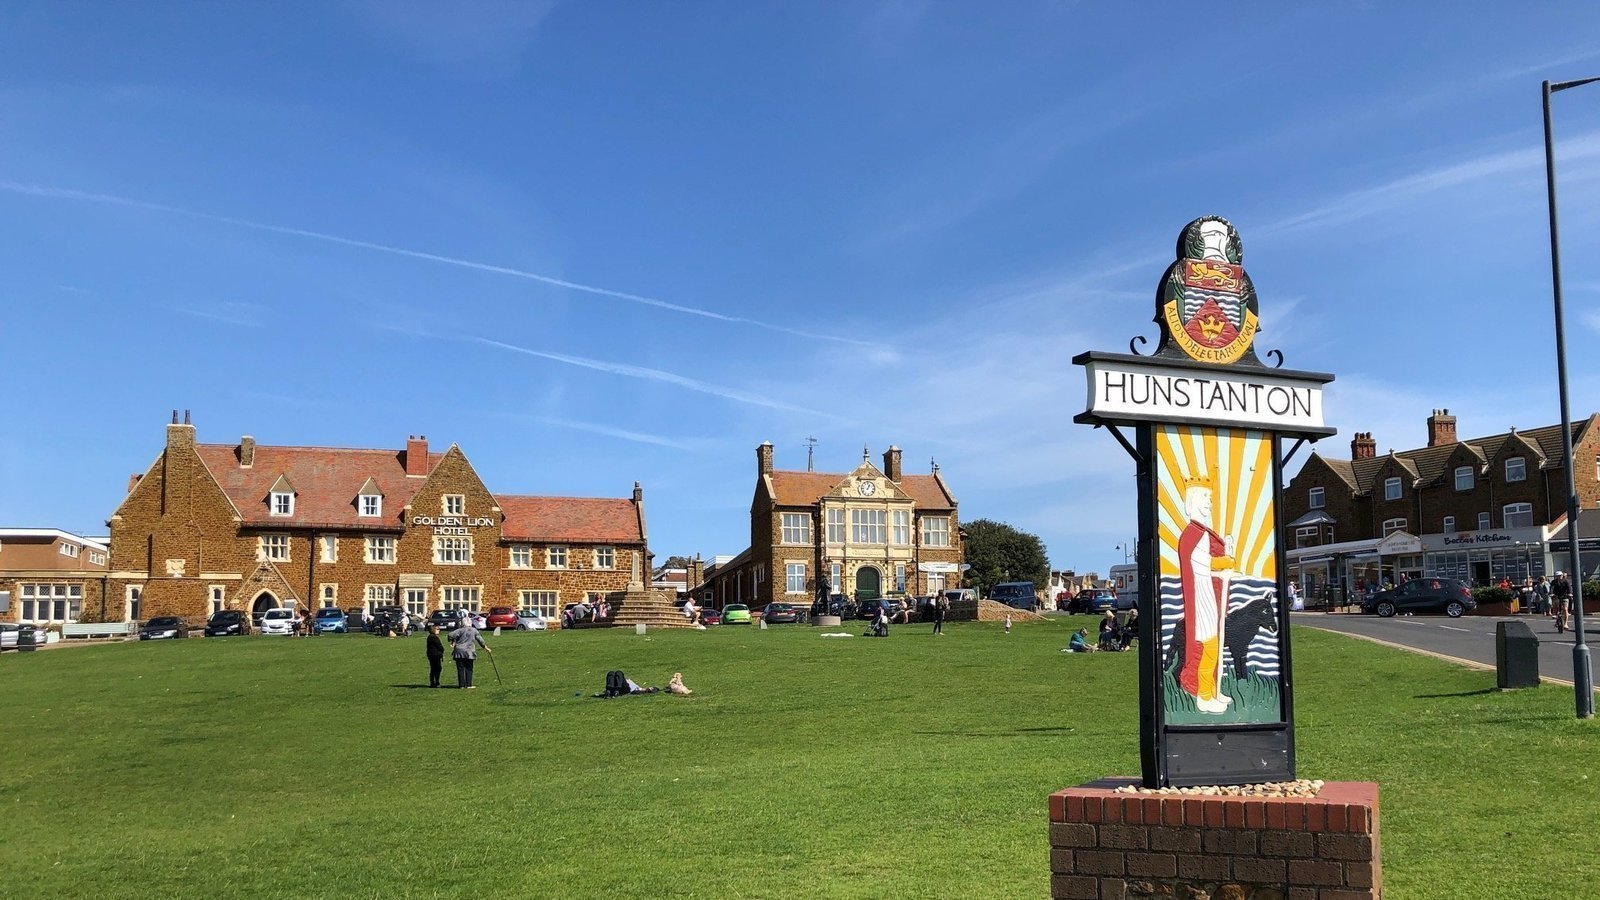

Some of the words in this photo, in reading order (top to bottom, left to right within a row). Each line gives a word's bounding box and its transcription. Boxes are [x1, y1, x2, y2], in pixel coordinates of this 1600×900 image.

[1104, 372, 1311, 417] HUNSTANTON
[413, 516, 463, 526] GOLDEN
[467, 517, 494, 527] LION
[433, 526, 473, 535] HOTEL
[1475, 533, 1512, 543] Kitchen
